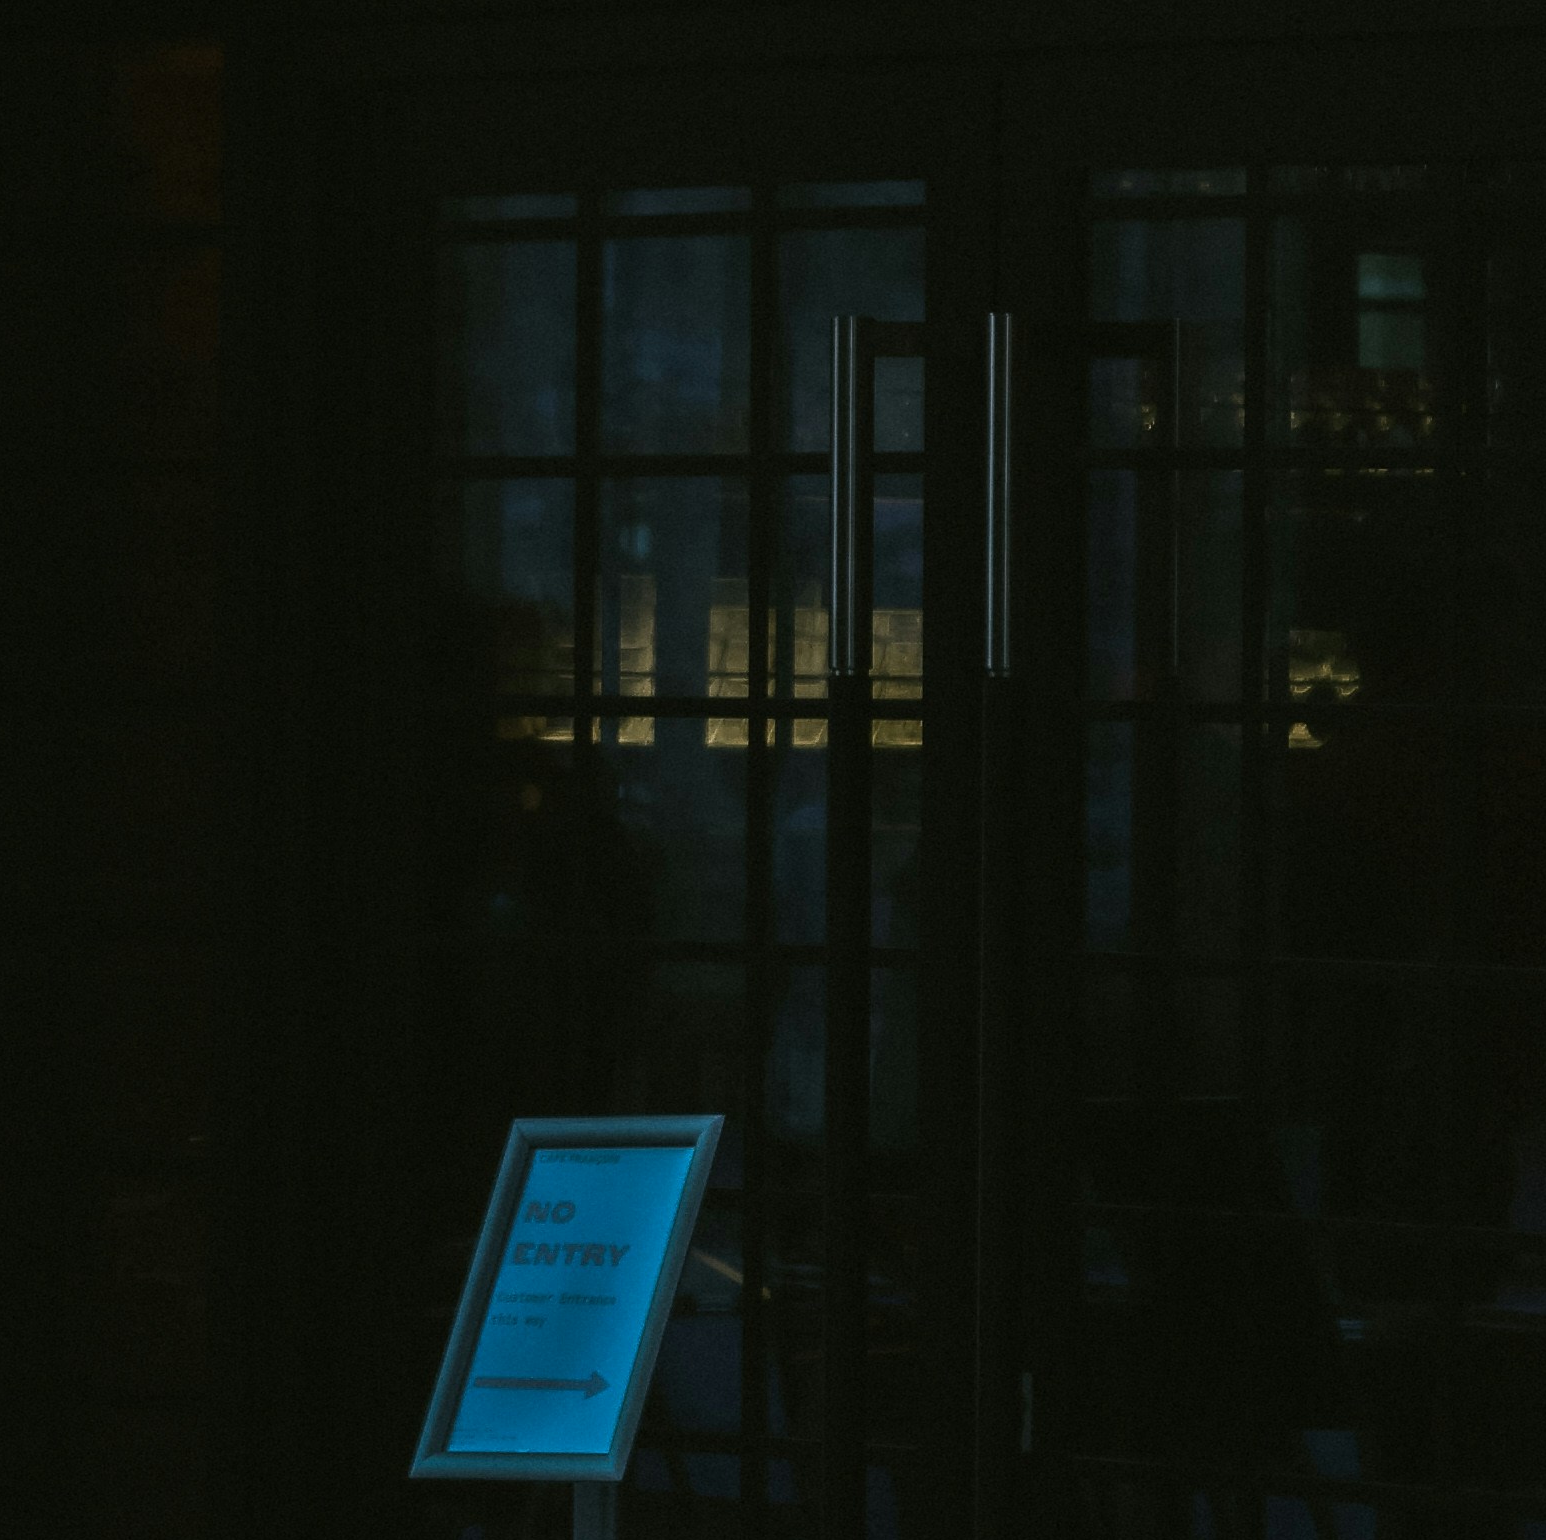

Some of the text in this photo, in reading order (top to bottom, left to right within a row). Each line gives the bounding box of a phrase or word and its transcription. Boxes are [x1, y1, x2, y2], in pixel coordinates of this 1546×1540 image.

[525, 1200, 576, 1224] NO
[511, 1242, 631, 1266] ENTRY
[559, 1292, 618, 1306] Entrance
[490, 1314, 548, 1330] this way
